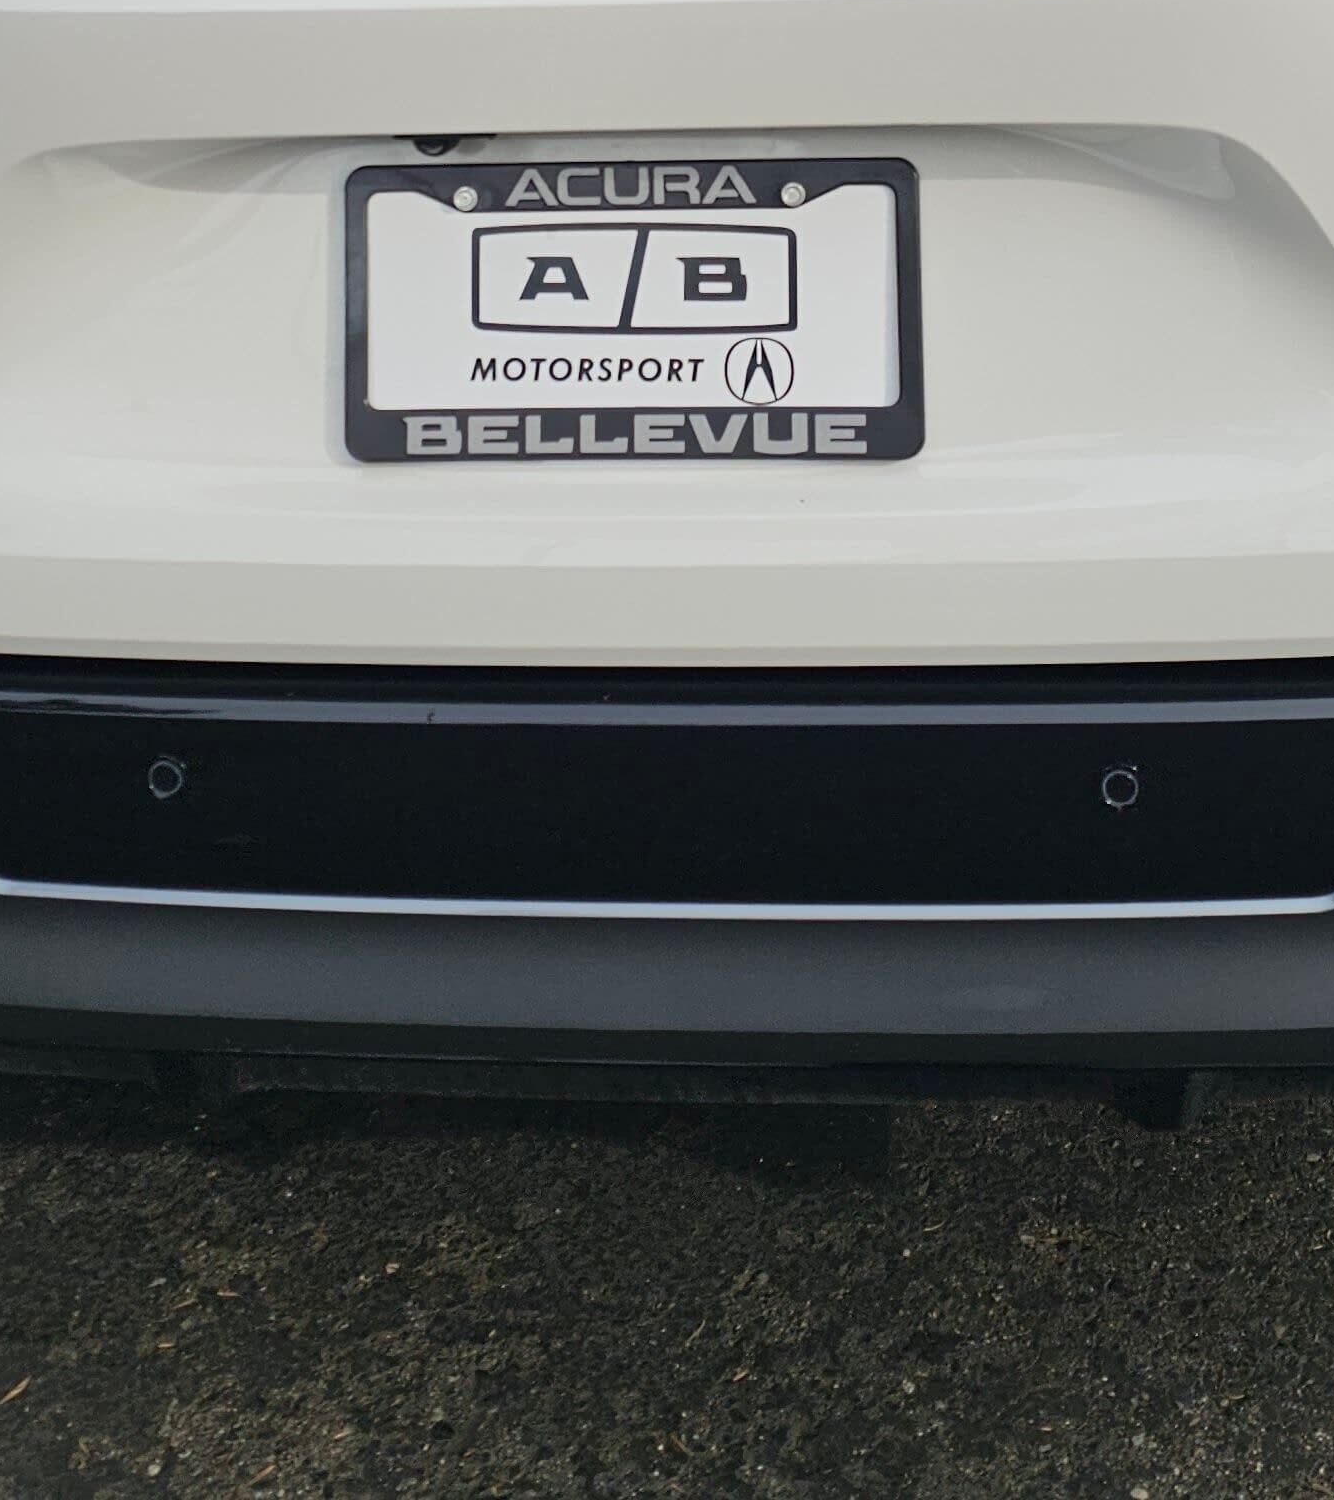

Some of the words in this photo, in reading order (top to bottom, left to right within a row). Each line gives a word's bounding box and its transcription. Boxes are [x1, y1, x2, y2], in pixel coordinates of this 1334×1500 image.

[505, 165, 757, 208] ACURA
[519, 256, 589, 300] A
[676, 257, 748, 301] B
[470, 357, 705, 382] MOTORSPORT
[402, 413, 868, 456] BELLEVUE
